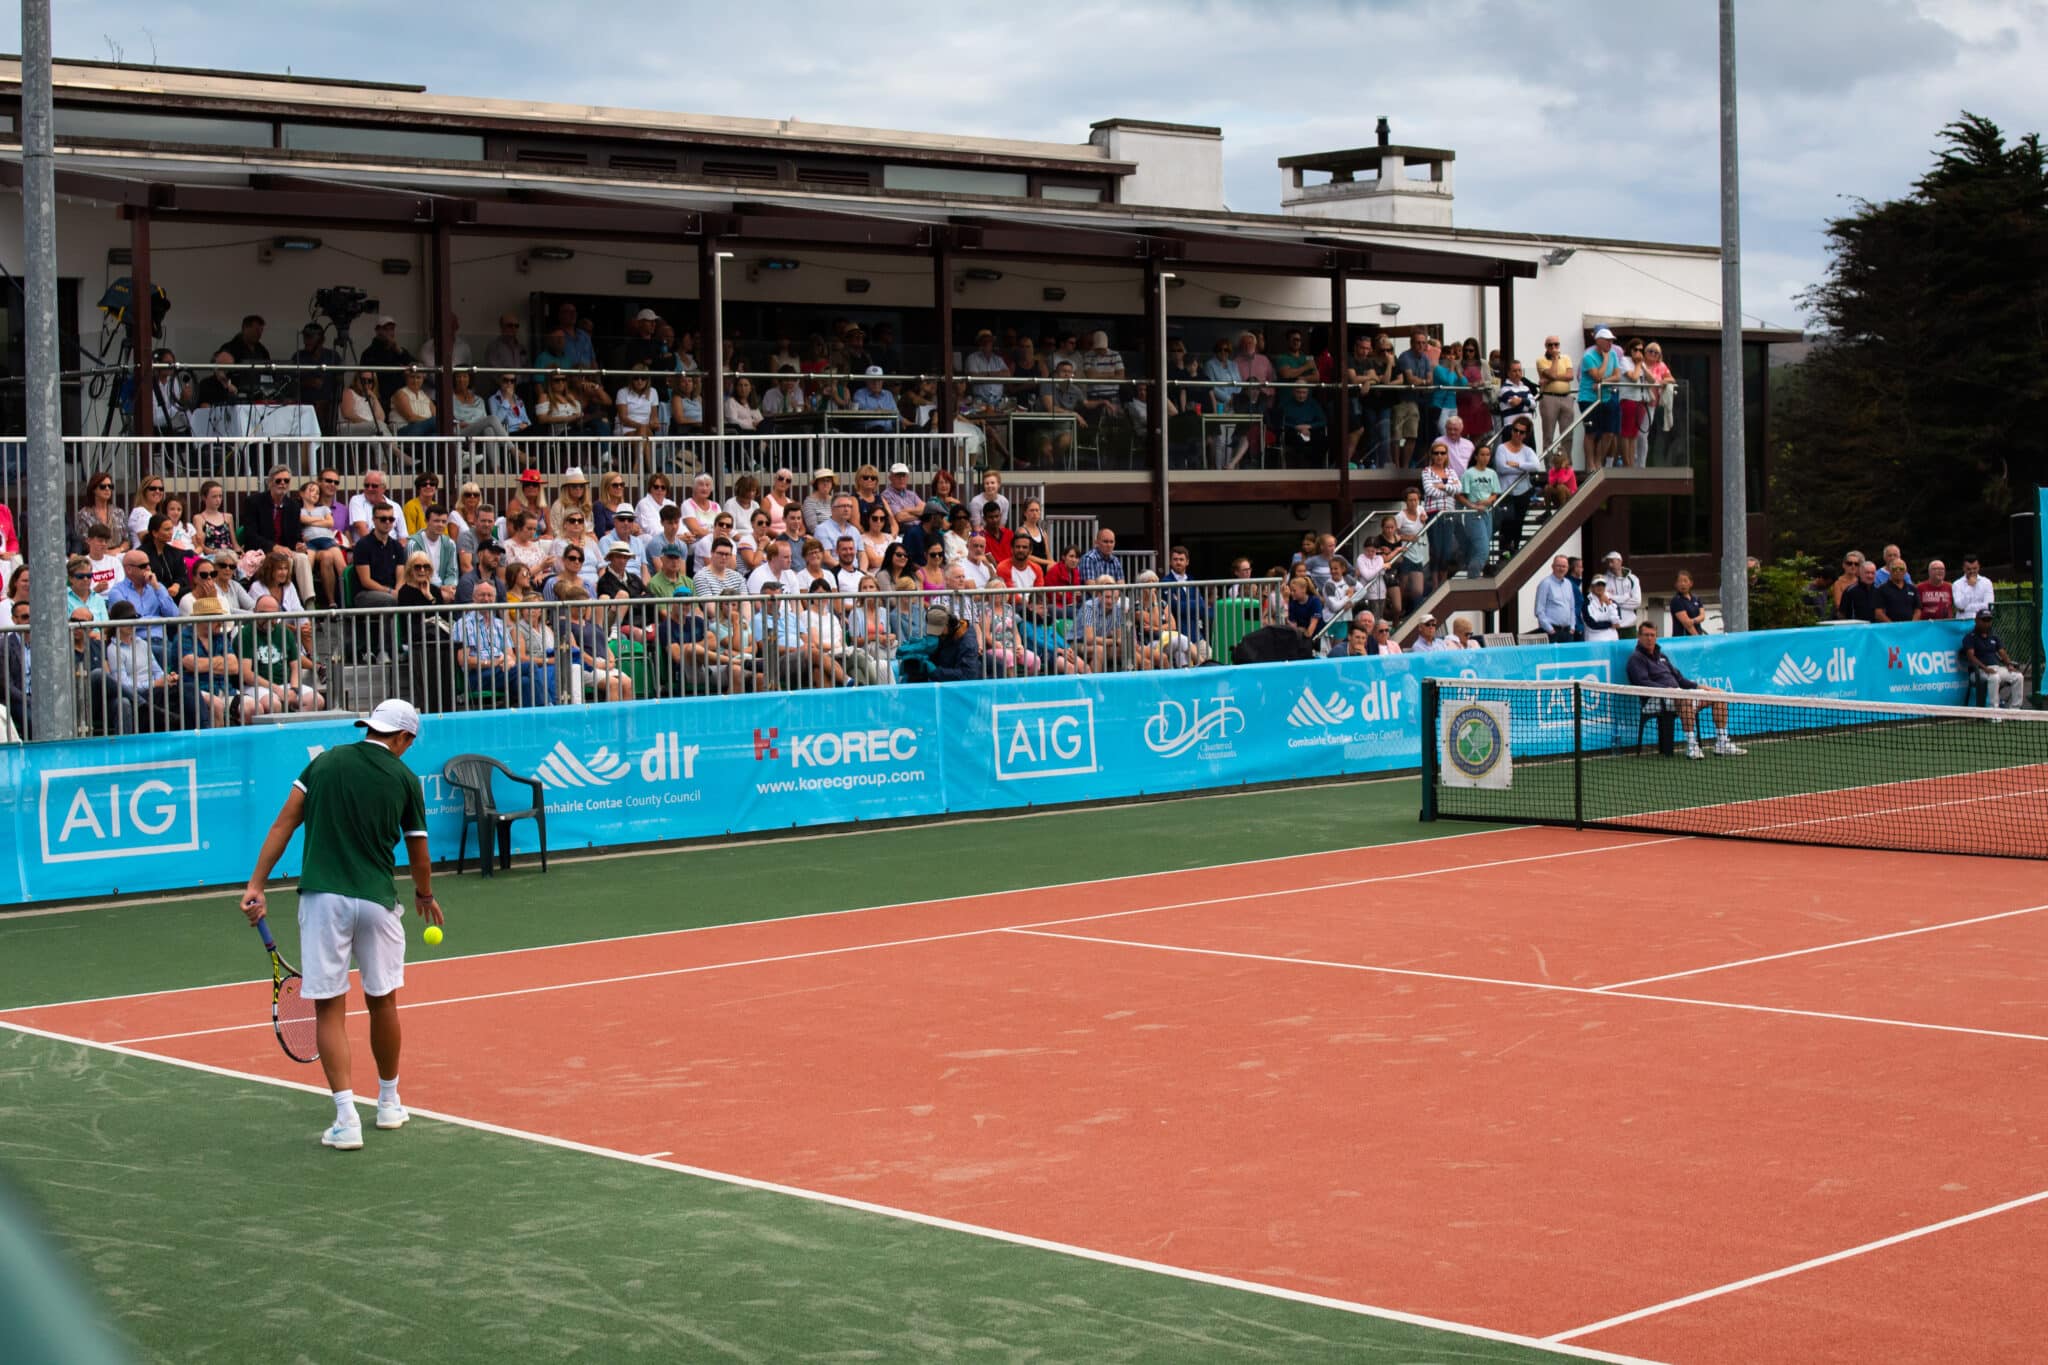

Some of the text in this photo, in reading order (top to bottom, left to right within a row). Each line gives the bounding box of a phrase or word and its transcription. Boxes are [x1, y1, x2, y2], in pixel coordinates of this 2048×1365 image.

[1827, 648, 1857, 682] dlr
[1361, 680, 1402, 722] dlr
[1007, 715, 1081, 764] AIG
[1150, 696, 1240, 750] DLT
[641, 731, 699, 783] dlr
[791, 727, 918, 768] KOREC
[544, 790, 701, 814] mhairle Contae County Council
[756, 770, 925, 794] www.korecgroup.com
[59, 779, 177, 842] AIG
